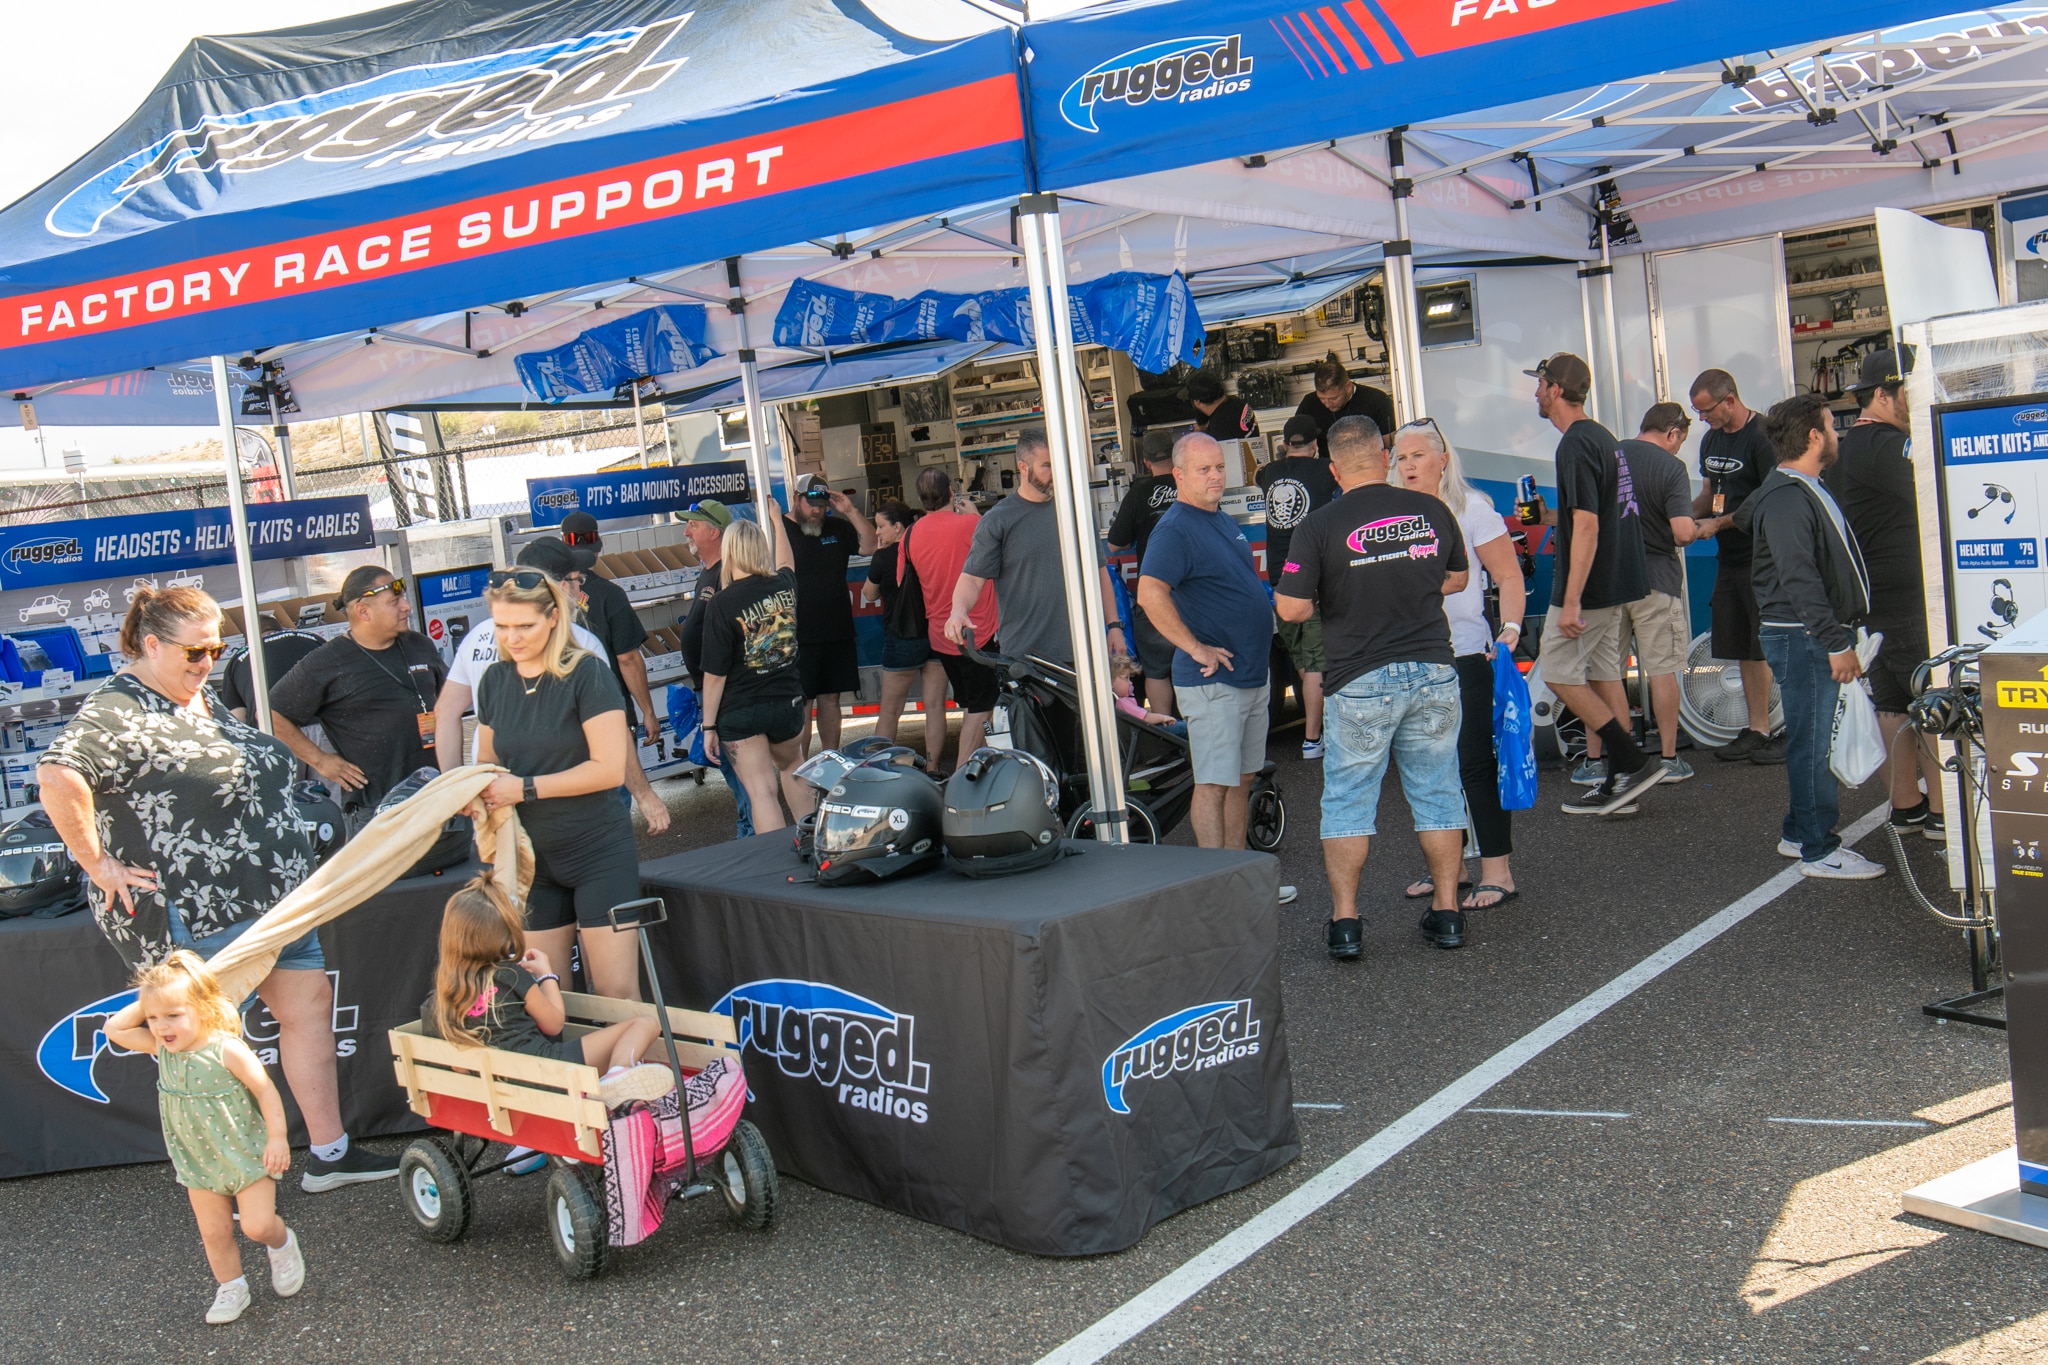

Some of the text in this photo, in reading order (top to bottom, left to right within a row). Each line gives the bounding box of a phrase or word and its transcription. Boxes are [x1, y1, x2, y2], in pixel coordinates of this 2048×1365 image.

[1179, 79, 1251, 103] radios
[363, 102, 633, 168] radios
[21, 145, 784, 336] FACTORY RACE SUPPORT
[1951, 434, 2000, 457] HELMET
[2001, 431, 2031, 454] KITS
[587, 473, 745, 507] PTT'S BAR MOUNTS ACCESSORIES
[95, 512, 360, 563] HEADSETS HELMT KITS CABLES
[1399, 530, 1430, 542] radios
[53, 553, 83, 565] radios
[1959, 542, 2034, 557] HELMET KIT $79
[441, 577, 458, 593] MAC
[893, 814, 906, 824] XL
[915, 841, 929, 852] BELL
[2024, 870, 2044, 878] STEREO
[1195, 1041, 1260, 1072] radios
[838, 1080, 929, 1124] radios
